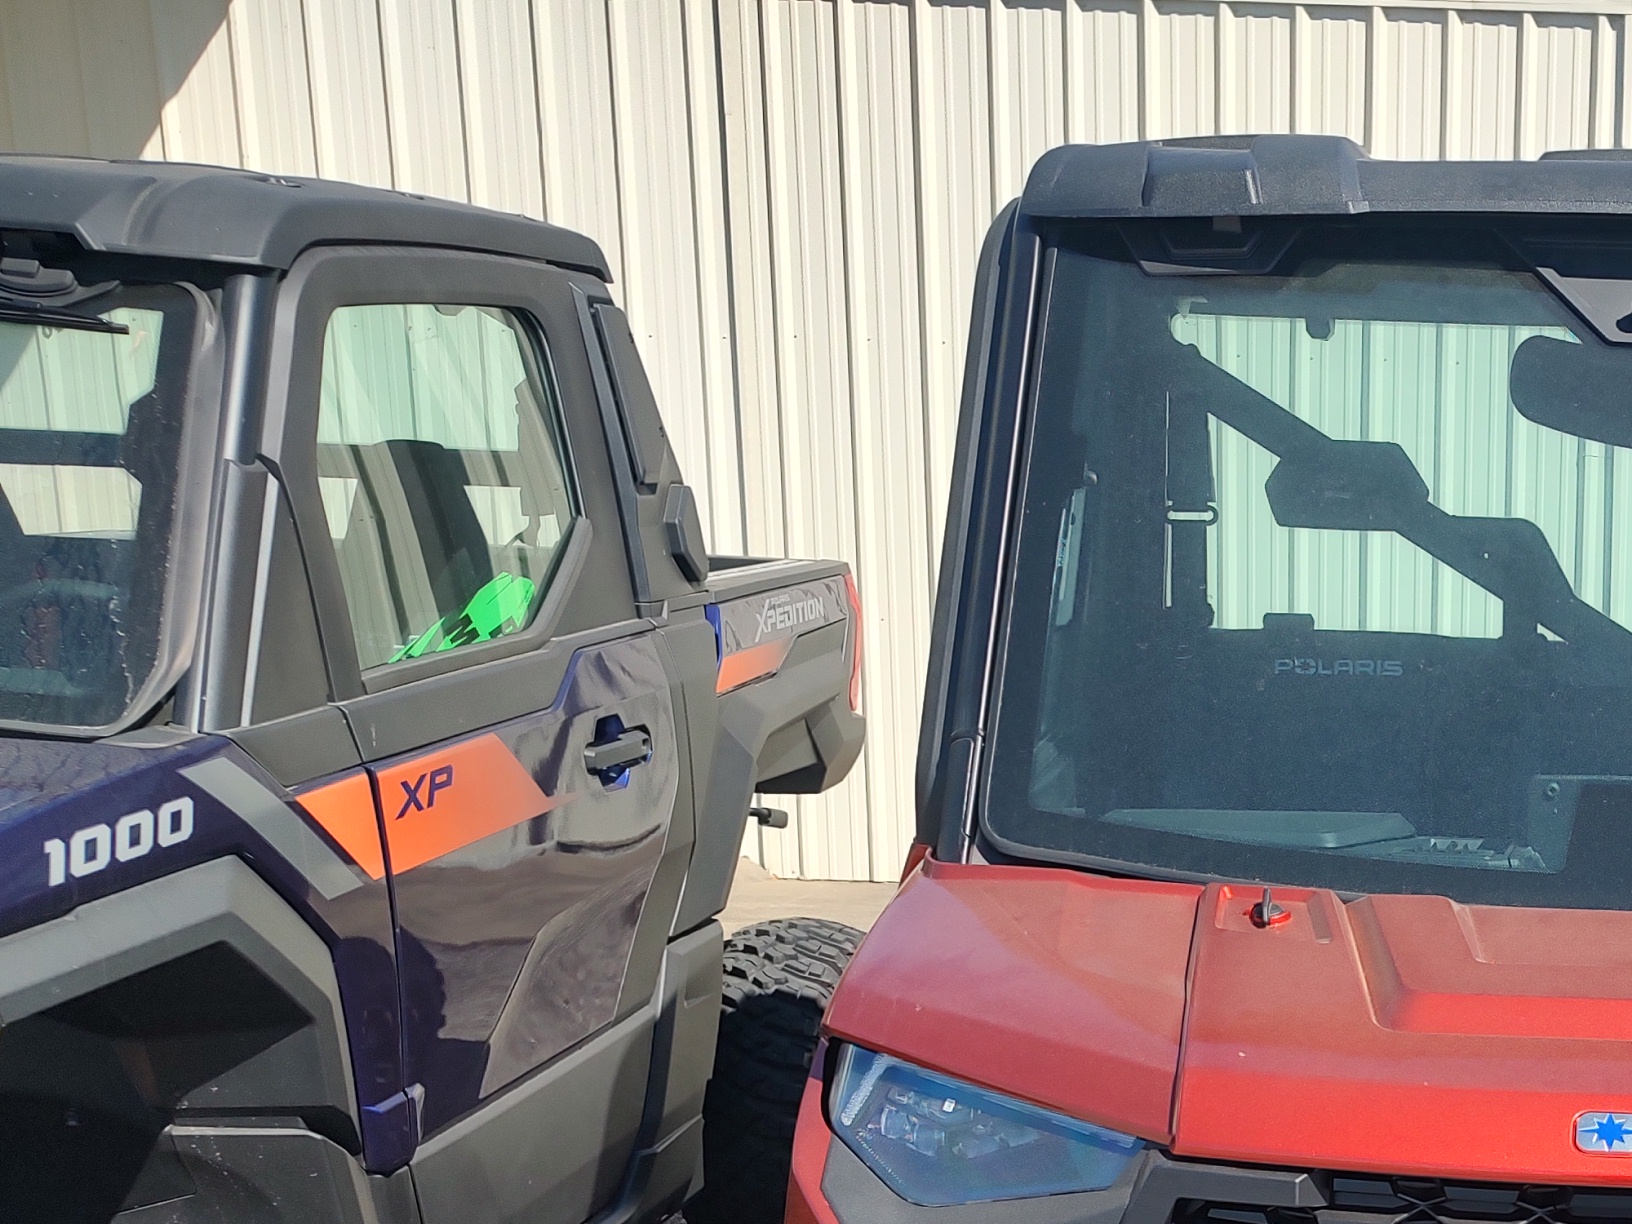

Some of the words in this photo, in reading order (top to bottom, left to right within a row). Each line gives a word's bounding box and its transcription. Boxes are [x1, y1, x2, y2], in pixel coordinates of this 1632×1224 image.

[754, 596, 825, 643] XPEDITION
[1274, 658, 1404, 676] POLARIS
[394, 764, 453, 820] XP
[43, 796, 195, 887] 1000
